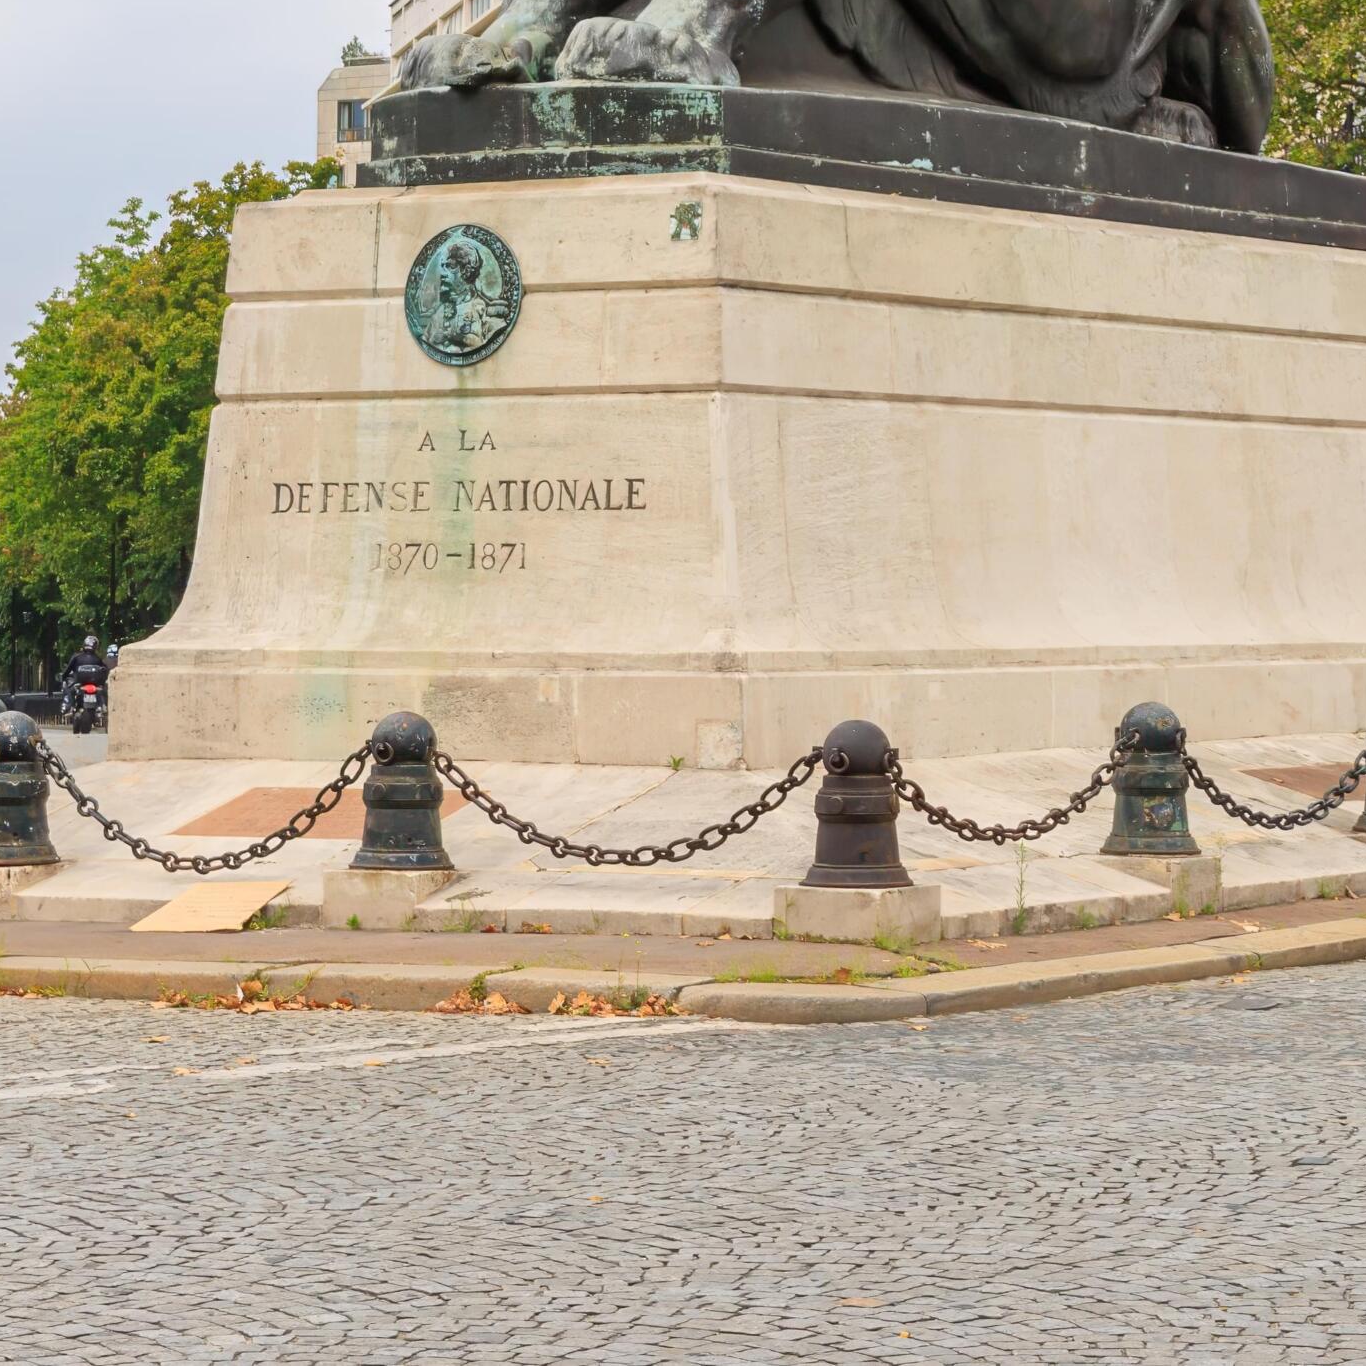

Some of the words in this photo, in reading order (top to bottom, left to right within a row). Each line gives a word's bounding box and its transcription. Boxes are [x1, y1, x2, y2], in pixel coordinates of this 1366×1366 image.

[418, 430, 436, 452] A
[458, 429, 497, 452] LA
[271, 482, 431, 515] DEFENSE
[452, 478, 647, 512] NATIONALE
